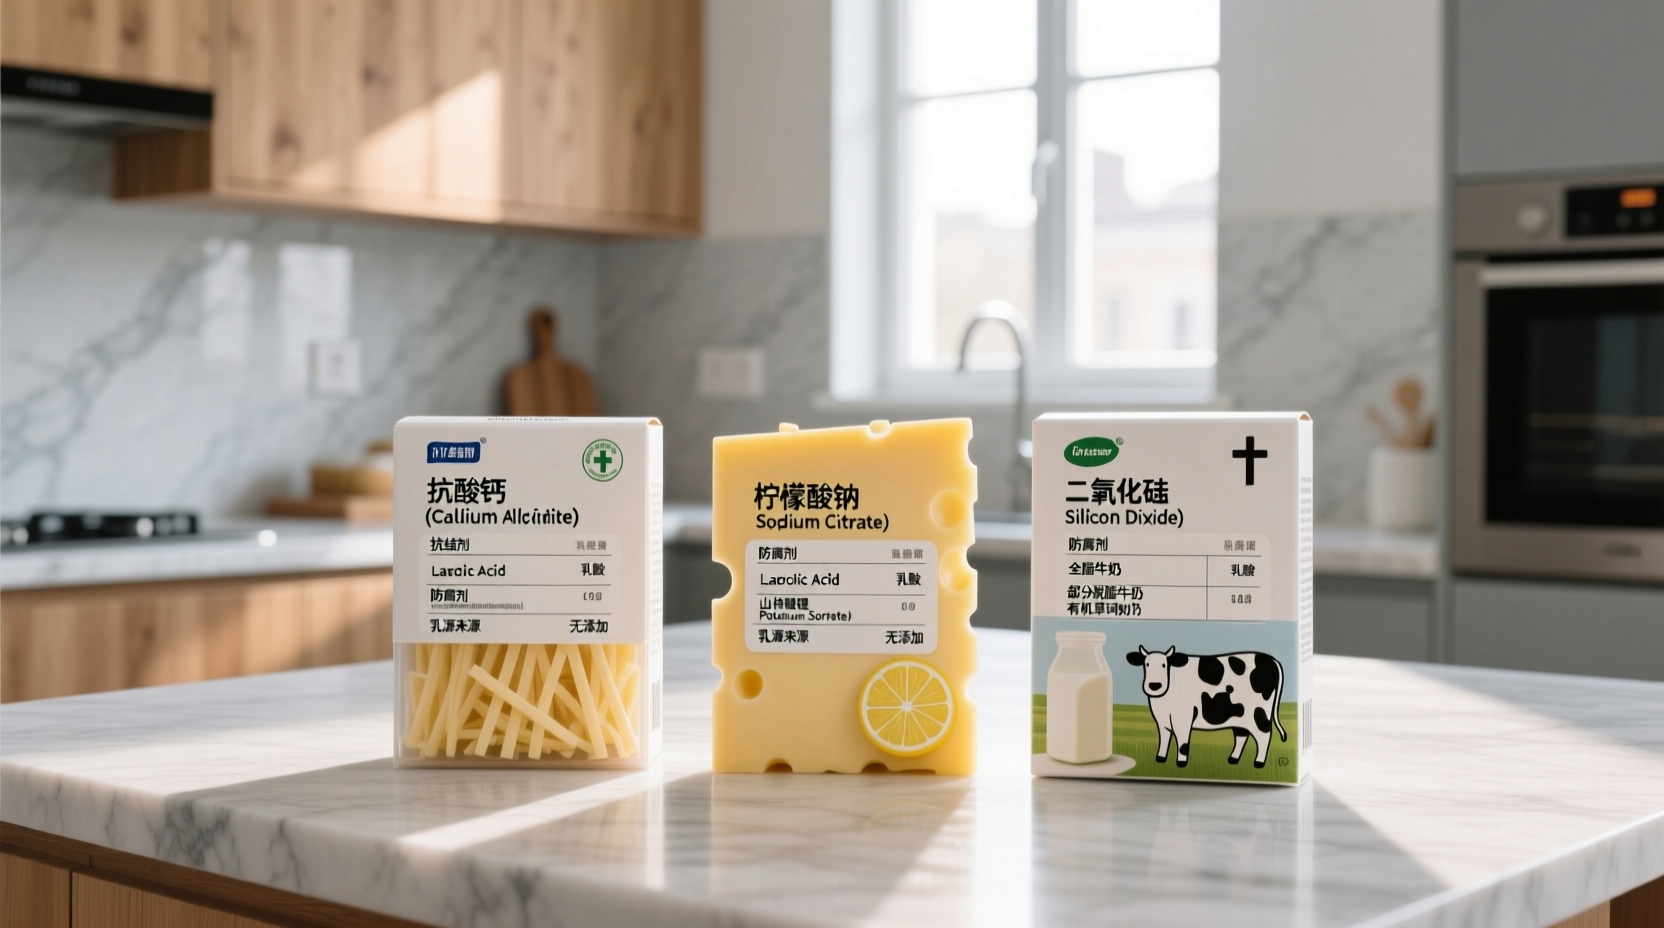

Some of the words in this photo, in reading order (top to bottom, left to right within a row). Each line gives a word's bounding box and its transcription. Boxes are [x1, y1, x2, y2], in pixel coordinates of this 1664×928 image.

[426, 476, 507, 504] 抗酸钙
[753, 482, 859, 511] 柠檬酸钠
[1065, 477, 1169, 506] 二氧化硅
[756, 513, 820, 531] Sodium
[825, 513, 889, 533] Citrate)
[1065, 508, 1120, 525] Silicon
[1125, 508, 1184, 529] Dixide)
[477, 564, 506, 577] Acid
[811, 572, 840, 586] Acid
